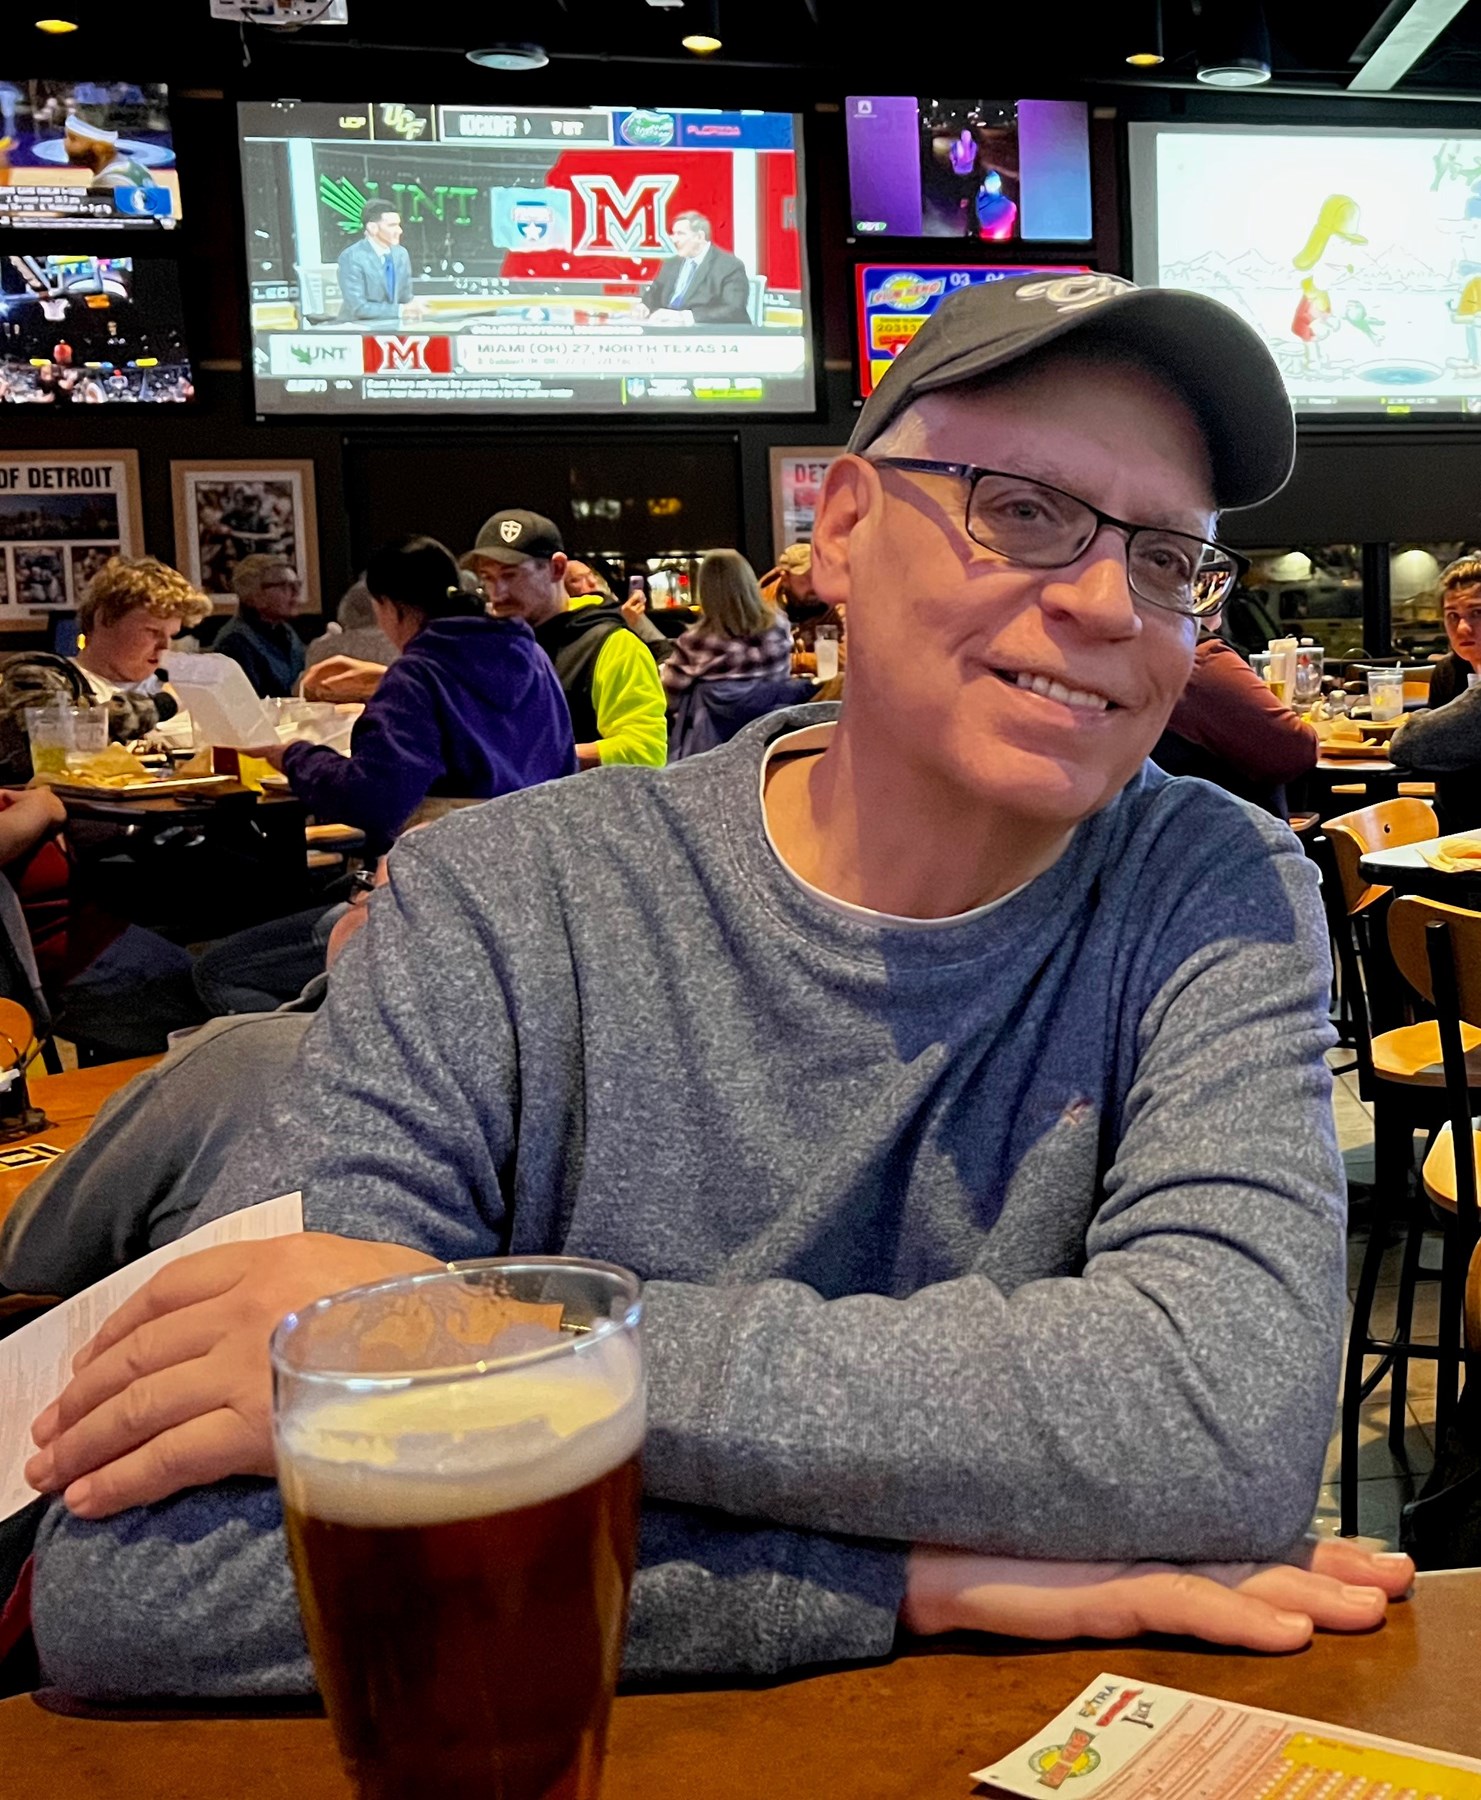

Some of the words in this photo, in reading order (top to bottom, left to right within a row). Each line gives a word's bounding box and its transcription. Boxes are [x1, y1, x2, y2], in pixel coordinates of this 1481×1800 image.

[380, 103, 427, 140] UCF
[571, 174, 681, 258] M
[309, 347, 348, 360] UNT
[374, 335, 431, 374] M
[477, 344, 525, 354] MIAMI
[529, 343, 567, 354] (OH)
[572, 344, 595, 355] 27,
[599, 344, 658, 354] NORTH
[663, 344, 716, 354] TEXAS
[720, 344, 740, 354] 14
[0, 467, 19, 488] OF
[28, 467, 112, 488] DETROIT
